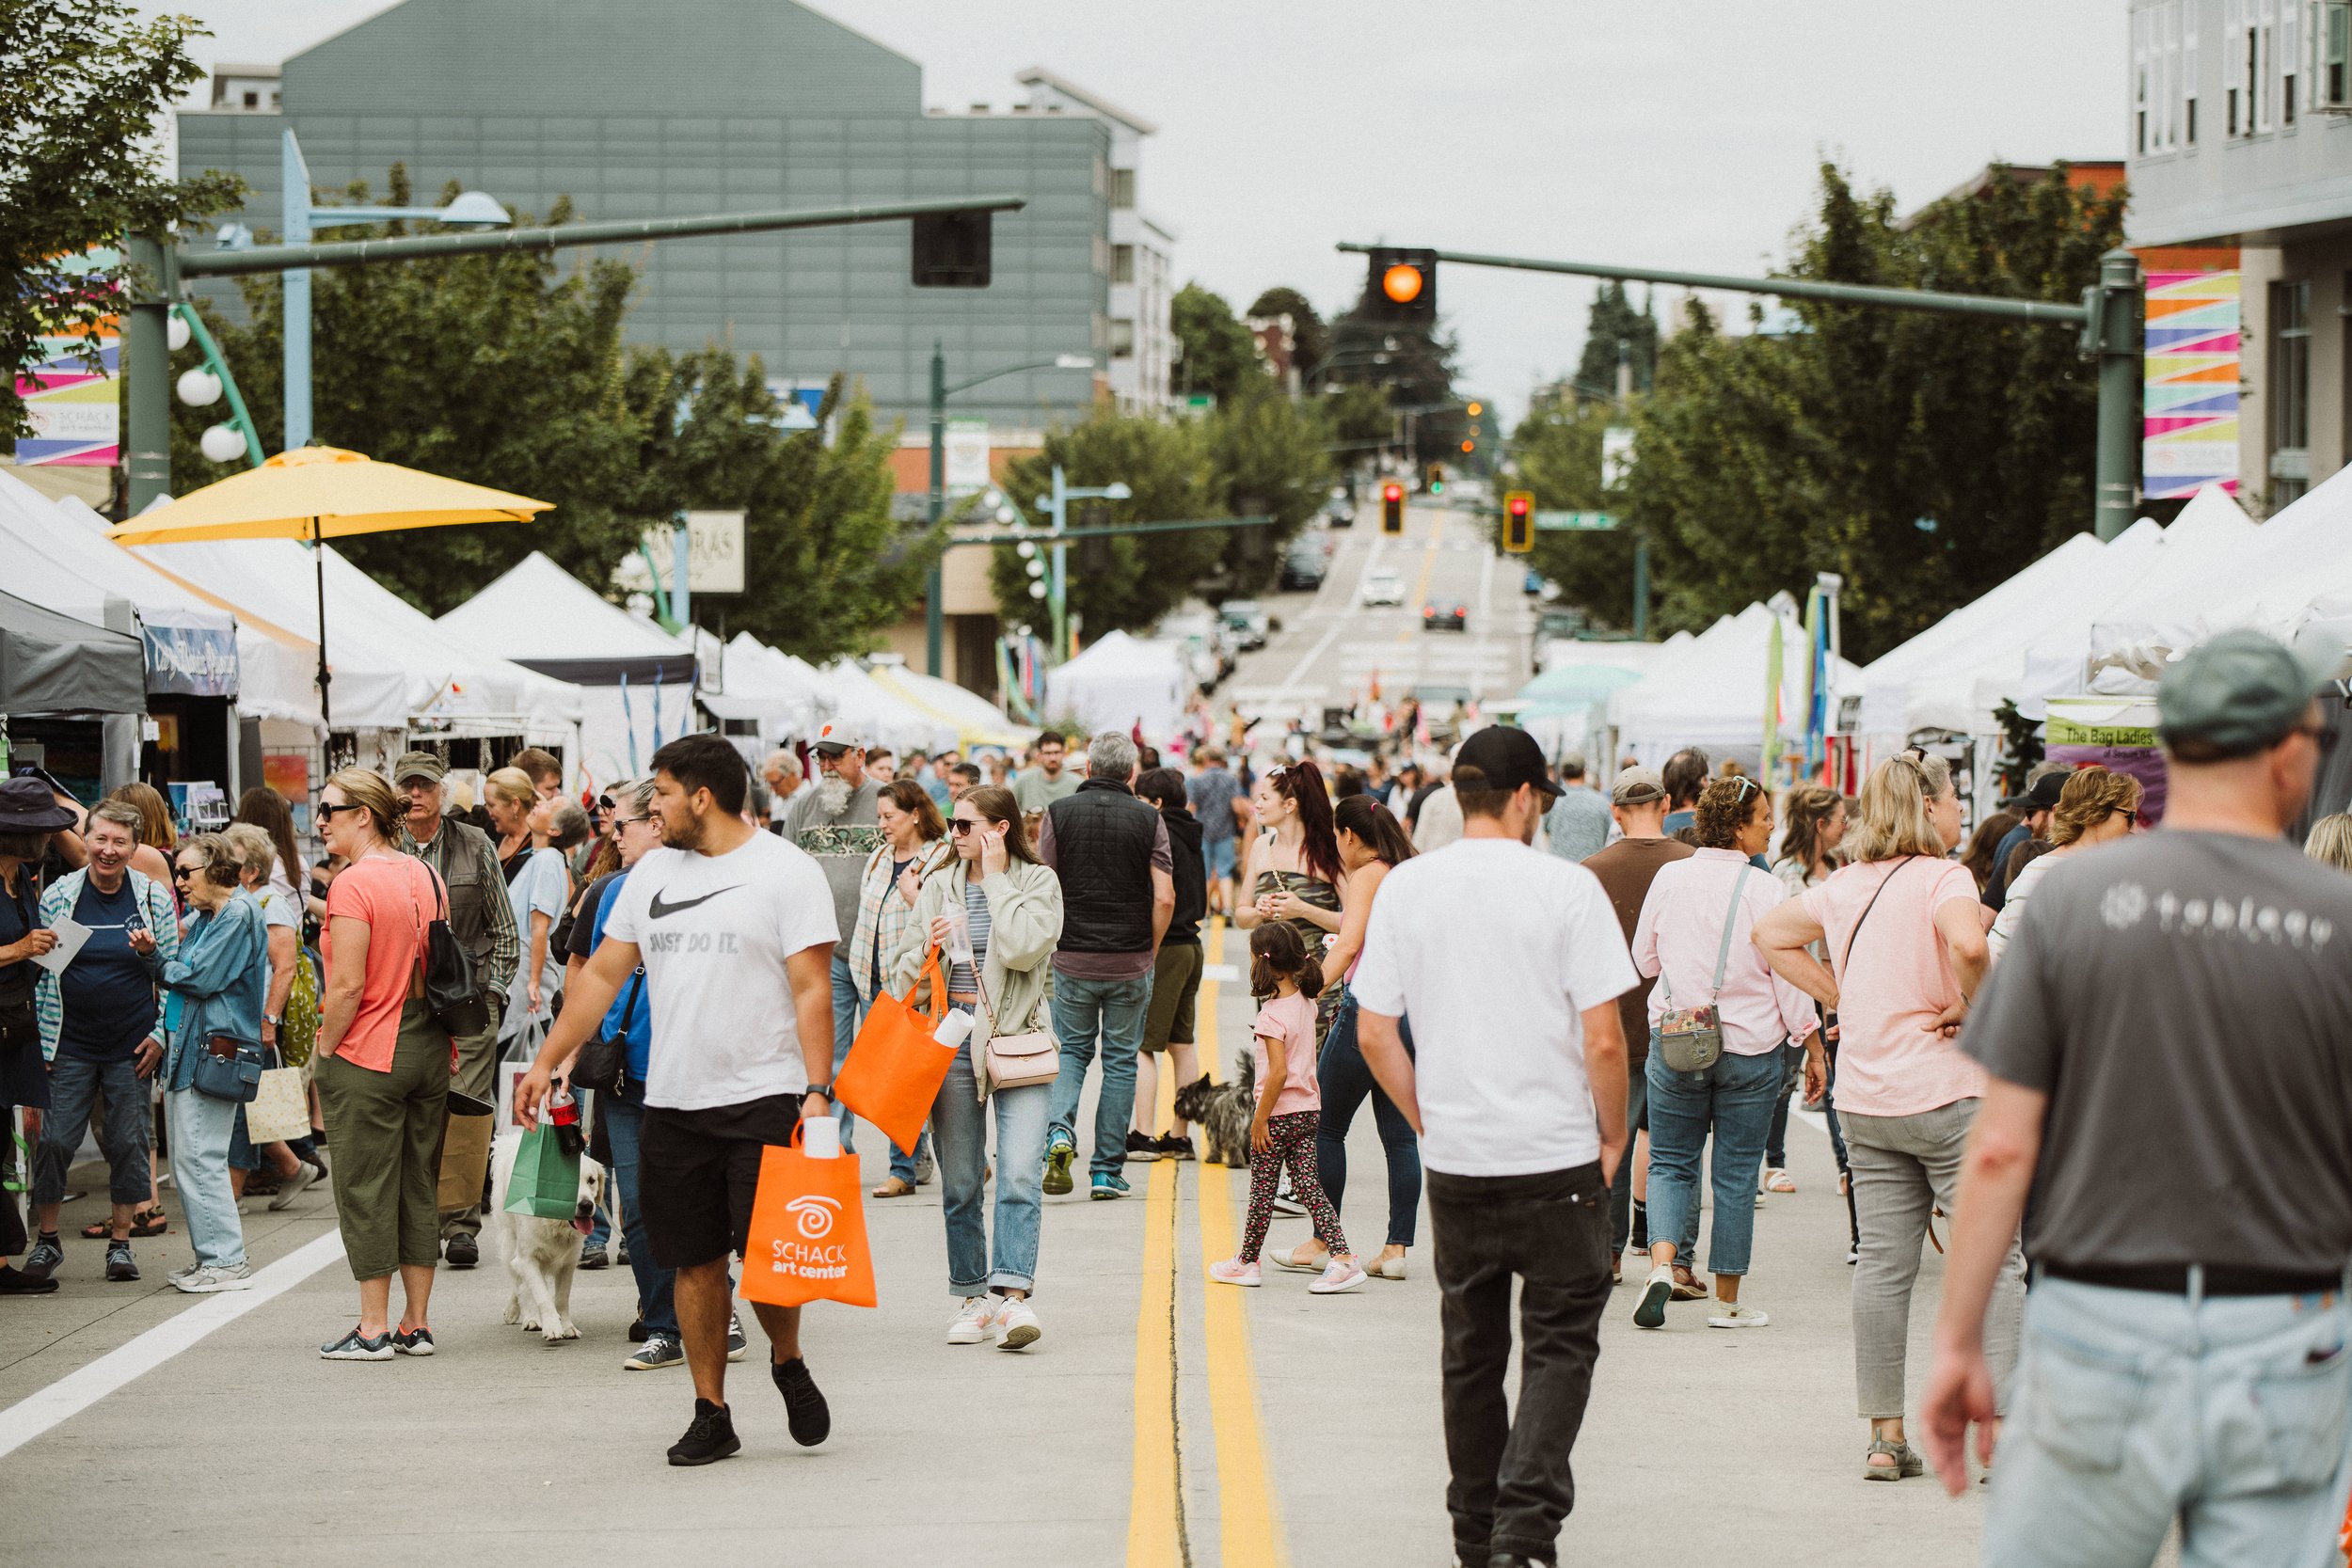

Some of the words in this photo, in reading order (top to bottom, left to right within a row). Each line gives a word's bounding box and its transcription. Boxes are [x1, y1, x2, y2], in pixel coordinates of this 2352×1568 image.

[2065, 727, 2087, 743] The
[2090, 729, 2113, 747] Bag
[2116, 729, 2153, 745] Ladies
[649, 932, 683, 953] JUST
[687, 932, 711, 953] DO
[772, 1239, 847, 1264] SCHACK
[771, 1260, 797, 1275] art
[799, 1265, 848, 1279] center
